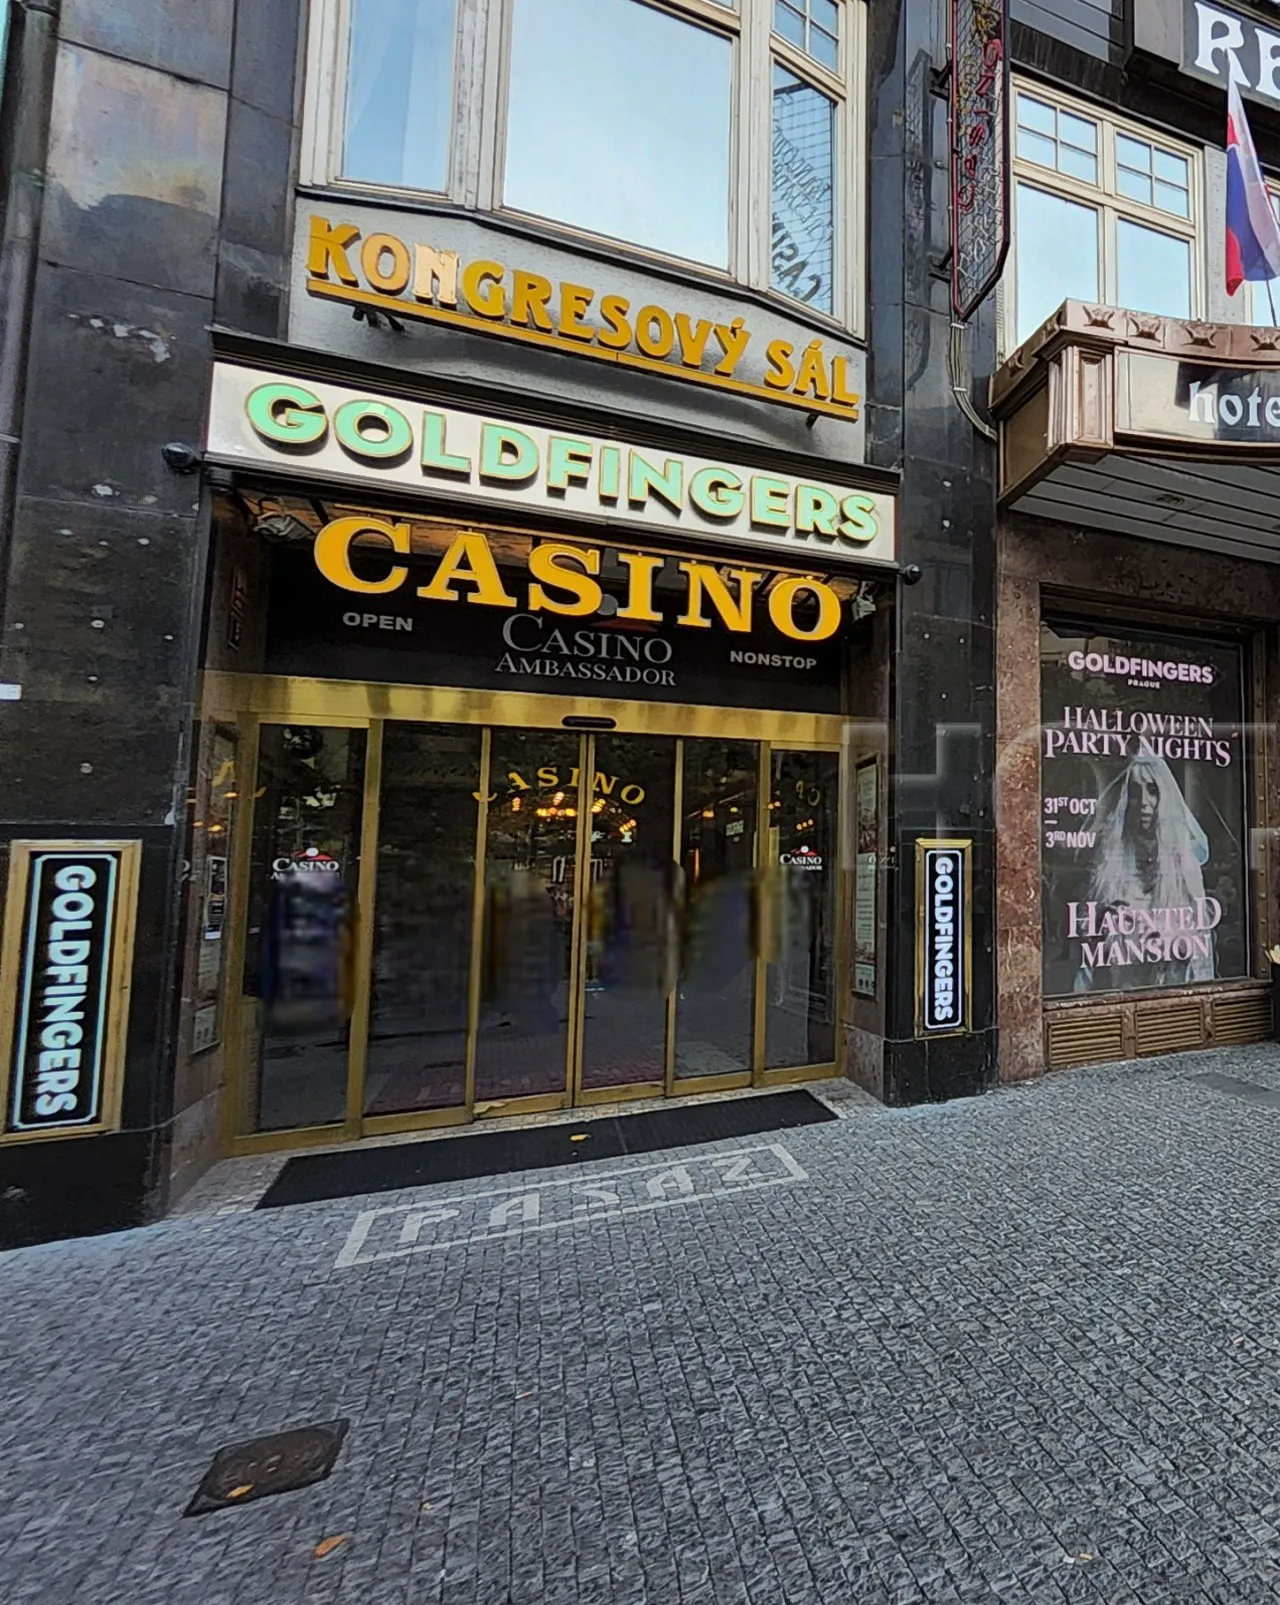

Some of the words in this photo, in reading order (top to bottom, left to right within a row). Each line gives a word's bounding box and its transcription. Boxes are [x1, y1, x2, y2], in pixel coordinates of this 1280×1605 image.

[306, 214, 751, 375] KONGRESOVÝ
[763, 339, 860, 407] SÁL
[244, 382, 879, 544] GOLDFINGERS
[314, 516, 842, 641] CASINO
[342, 612, 413, 631] OPEN
[495, 652, 677, 686] AMBASSADOR
[730, 650, 818, 669] NONSTOP
[1068, 651, 1214, 684] GOLDFINGERS
[1128, 678, 1160, 689] PRAGUE
[1063, 706, 1214, 738] HALLOWEEN
[1044, 729, 1131, 759] PARTY
[1137, 735, 1231, 768] NIGHTS
[472, 766, 646, 806] ASINO
[1044, 797, 1068, 814] 31ST
[1070, 798, 1097, 815] OCT
[1045, 832, 1066, 848] 3RD
[1067, 832, 1097, 848] NOV
[1067, 896, 1222, 938] HAUNTED
[934, 856, 954, 1022] GOLDFINGERS
[1080, 934, 1212, 968] MANSION
[36, 865, 97, 1116] GOLDFINGERS
